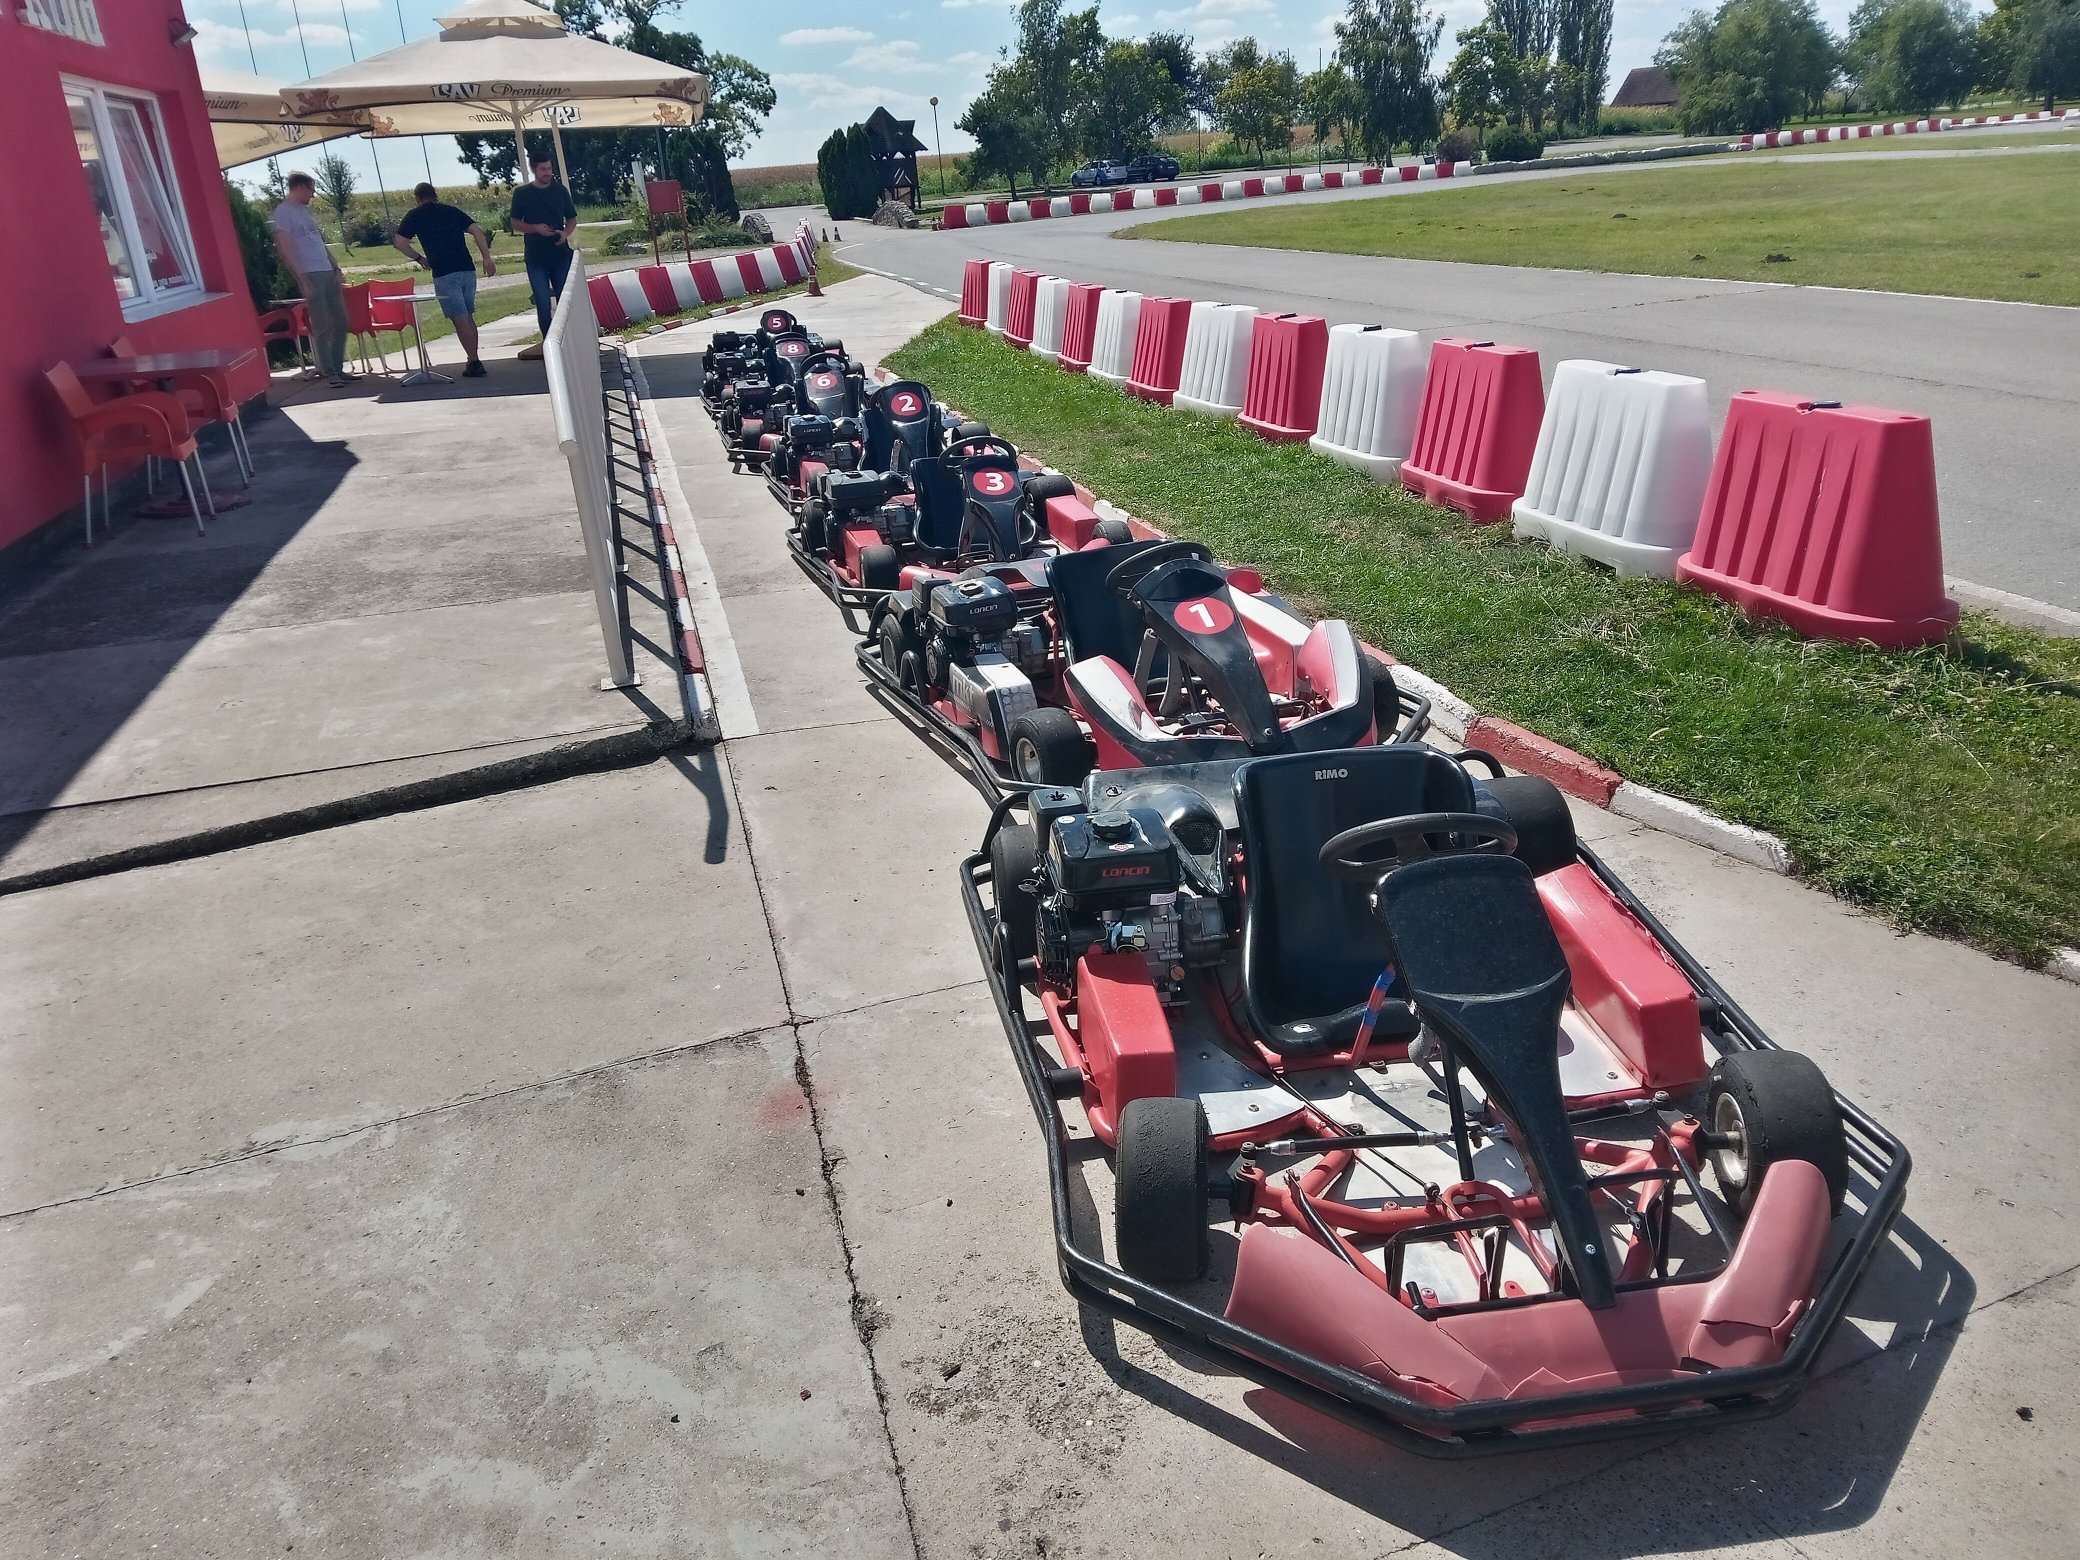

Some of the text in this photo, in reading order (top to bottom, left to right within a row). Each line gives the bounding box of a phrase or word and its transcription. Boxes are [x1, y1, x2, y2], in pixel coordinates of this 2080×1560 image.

[491, 83, 571, 97] Premium
[773, 318, 782, 328] 5
[787, 344, 799, 353] 8
[817, 375, 831, 387] 6
[898, 395, 917, 412] 2
[984, 472, 1005, 491] 3
[1189, 603, 1217, 628] 1
